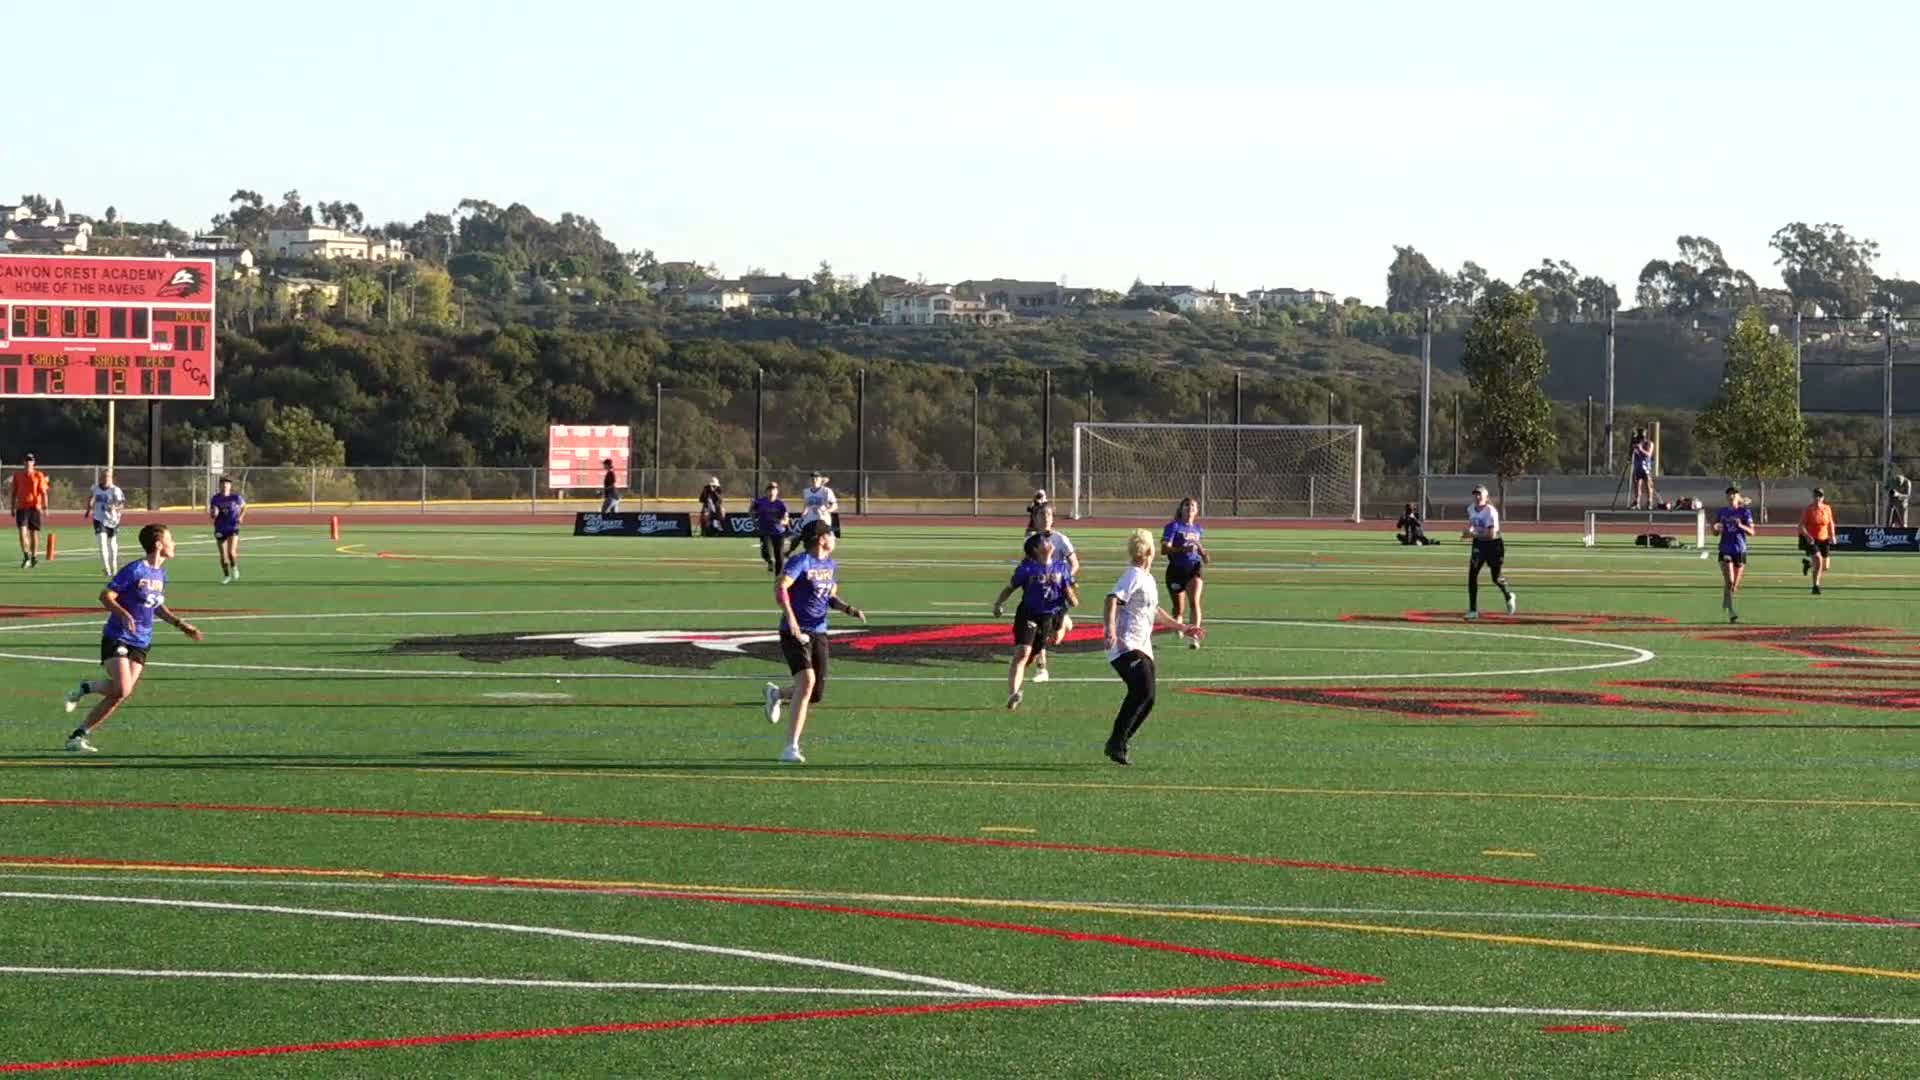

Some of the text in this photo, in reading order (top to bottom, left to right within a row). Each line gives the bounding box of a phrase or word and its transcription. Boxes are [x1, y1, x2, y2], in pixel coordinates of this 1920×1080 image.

[54, 267, 97, 279] CREST
[102, 268, 164, 281] ACADEMY
[15, 282, 145, 295] HOME OF THE RAVENS
[32, 354, 65, 366] SHOTS
[51, 369, 64, 392] 2
[114, 370, 126, 393] 2
